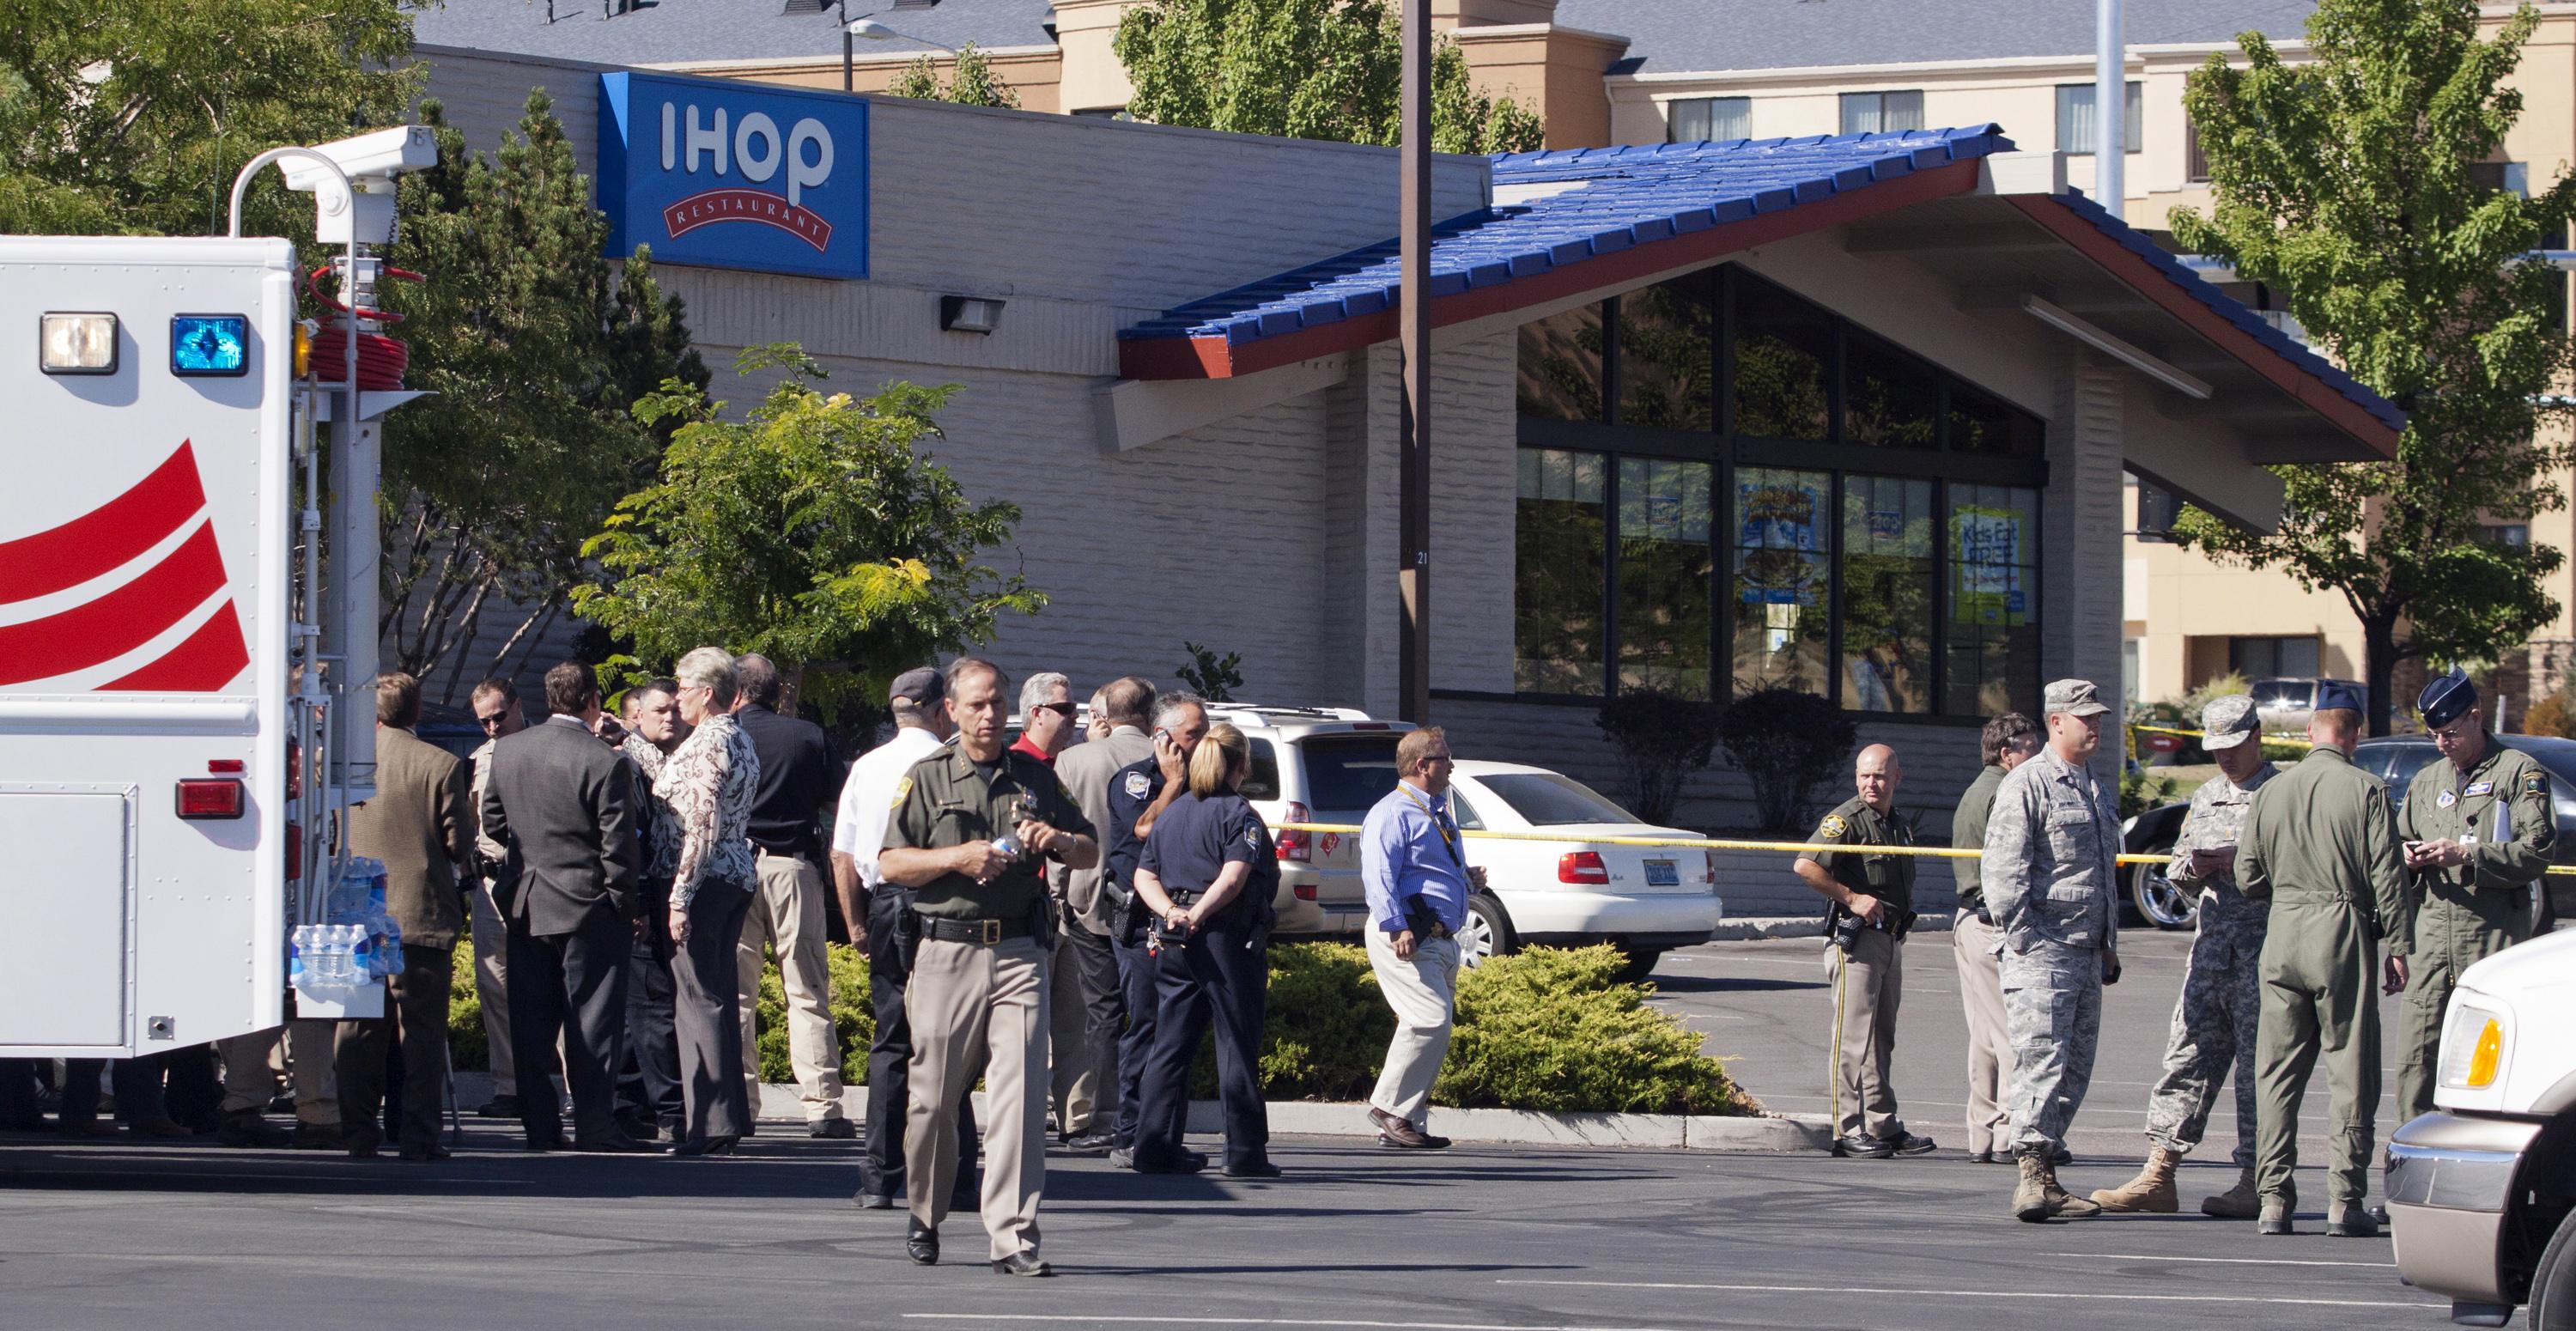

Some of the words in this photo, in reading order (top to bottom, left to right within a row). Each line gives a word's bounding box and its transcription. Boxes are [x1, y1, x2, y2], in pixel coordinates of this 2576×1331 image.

[662, 101, 834, 206] IHOP
[677, 198, 820, 237] RESTAURANT
[1963, 525, 1992, 544] Kids
[1995, 521, 2018, 543] Eat
[1418, 551, 1427, 564] 21
[1969, 545, 2014, 568] FREE
